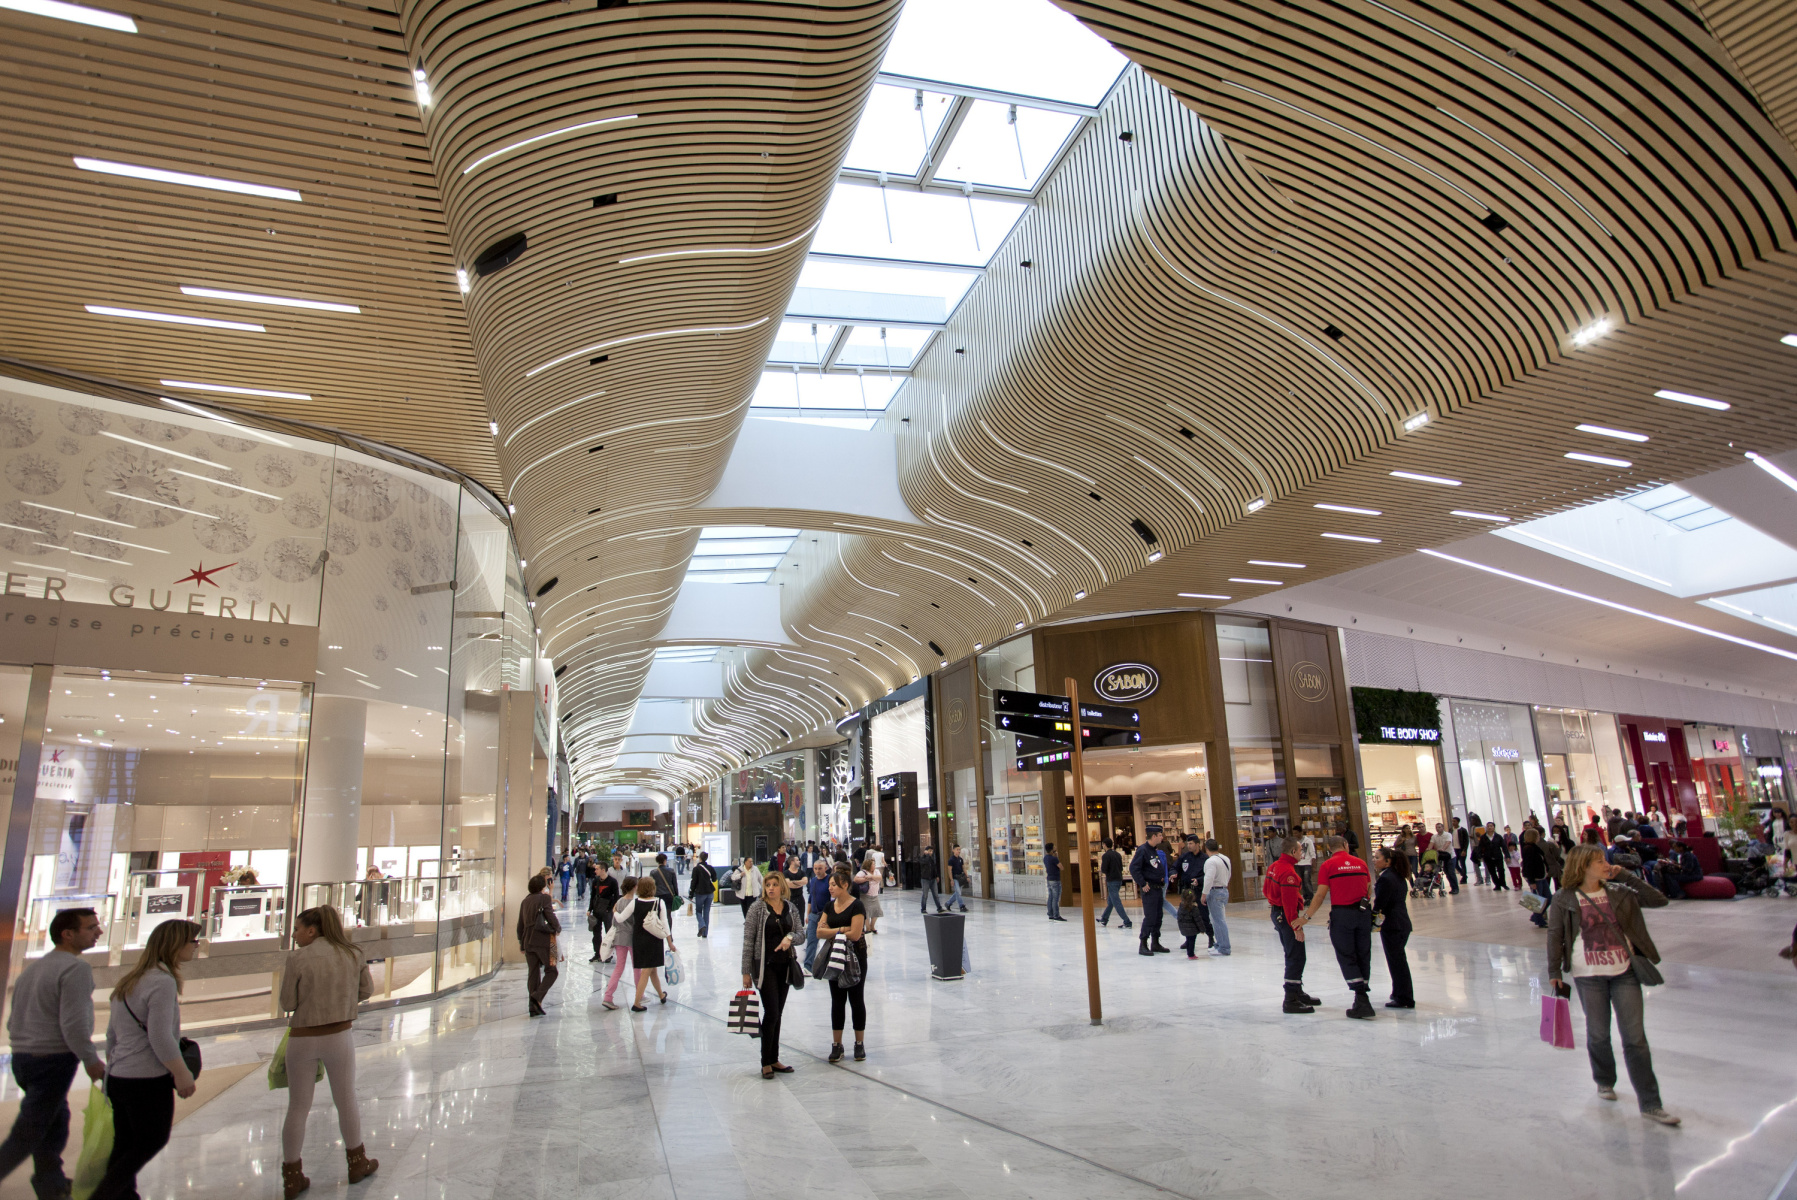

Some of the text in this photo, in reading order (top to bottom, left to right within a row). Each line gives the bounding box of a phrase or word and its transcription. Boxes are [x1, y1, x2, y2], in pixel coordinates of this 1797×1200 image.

[108, 584, 292, 625] GUERIN
[131, 622, 290, 648] précieuse
[1107, 673, 1147, 691] SABON
[1297, 671, 1322, 690] SABON
[1380, 726, 1439, 741] THE BODY SHOP
[0, 758, 75, 779] DI UERIN
[1584, 950, 1615, 967] MISS
